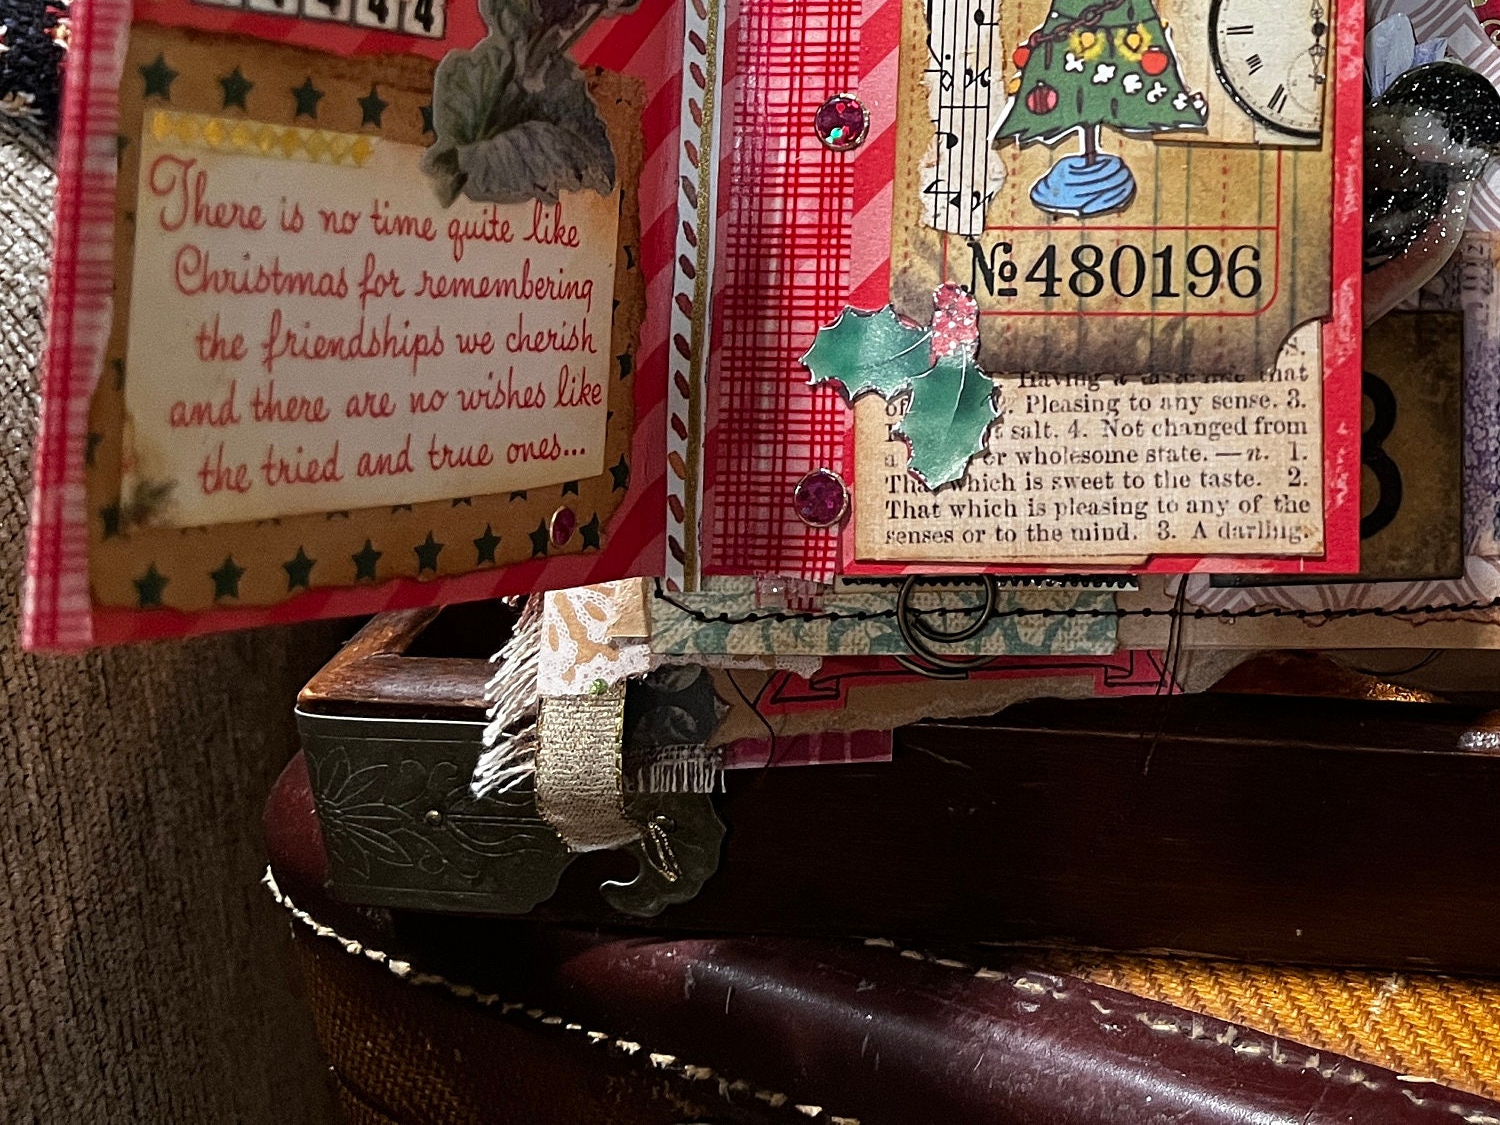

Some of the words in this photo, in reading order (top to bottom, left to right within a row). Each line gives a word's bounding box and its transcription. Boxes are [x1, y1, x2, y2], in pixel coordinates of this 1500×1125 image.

[149, 153, 267, 232] There
[281, 196, 304, 234] is
[317, 209, 362, 235] no
[370, 199, 437, 242] time
[448, 203, 514, 263] quite
[523, 199, 580, 248] like
[174, 243, 349, 299] Christmas
[358, 252, 406, 311] for
[414, 257, 594, 313] remembering
[195, 312, 248, 361] the
[261, 308, 445, 376] friendships
[455, 330, 496, 355] we
[506, 312, 597, 354] cherish
[170, 378, 242, 428] and
[252, 378, 330, 423] there
[345, 391, 397, 420] are
[410, 389, 448, 415] no
[457, 366, 546, 412] wishes
[554, 364, 603, 408] like
[1026, 394, 1121, 418] Pleasing
[1129, 393, 1151, 412] to
[1160, 396, 1203, 415] any
[1212, 393, 1278, 410] sense.
[1286, 388, 1307, 409] 3.
[1010, 420, 1059, 439] salt.
[1067, 418, 1088, 439] 4.
[1101, 418, 1145, 438] Not
[1151, 416, 1248, 441] changed
[1254, 416, 1308, 436] from
[197, 440, 252, 495] the
[260, 439, 344, 487] tried
[357, 433, 414, 477] and
[427, 433, 494, 471] true
[506, 433, 586, 465] ones...
[1015, 446, 1139, 466] wholesome
[1145, 445, 1208, 464] state.
[1288, 441, 1308, 461] 1.
[1025, 471, 1044, 491] is
[1052, 473, 1114, 491] sweet
[1123, 472, 1145, 489] to
[1154, 469, 1191, 488] the
[1200, 468, 1262, 488] taste.
[1287, 466, 1308, 488] 2.
[885, 500, 941, 519] That
[950, 498, 1018, 518] which
[1027, 497, 1047, 517] is
[1054, 496, 1148, 521] pleasing
[1157, 496, 1179, 514] to
[1186, 499, 1230, 517] any
[1238, 494, 1263, 514] of
[1273, 493, 1311, 514] the
[886, 529, 954, 545] senses
[962, 528, 986, 544] or
[995, 525, 1017, 543] to
[1026, 523, 1063, 543] the
[1071, 522, 1138, 542] mind.
[1157, 519, 1177, 541] 3.
[1191, 520, 1209, 540] A
